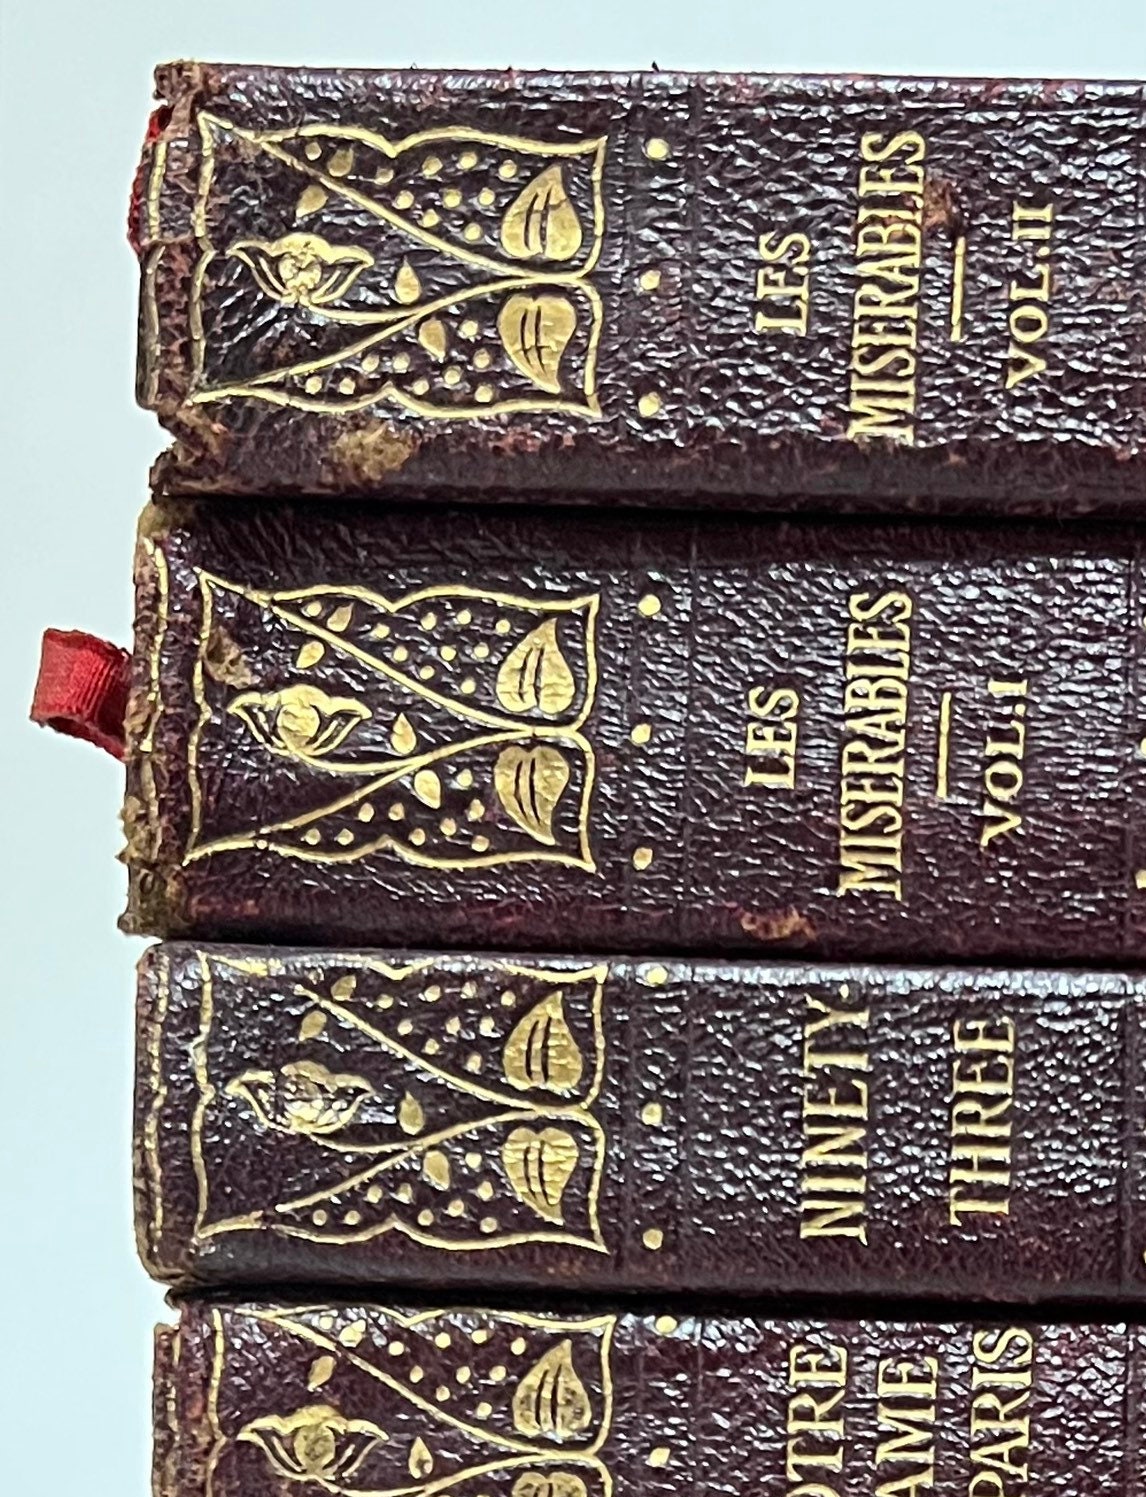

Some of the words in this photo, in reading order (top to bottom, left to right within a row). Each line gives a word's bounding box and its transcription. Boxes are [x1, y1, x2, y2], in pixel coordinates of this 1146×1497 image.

[755, 229, 812, 337] LES
[846, 129, 927, 447] MISERABLES
[745, 686, 799, 790] LES
[838, 589, 912, 902] MISERABLES
[951, 1015, 1016, 1226] THREE
